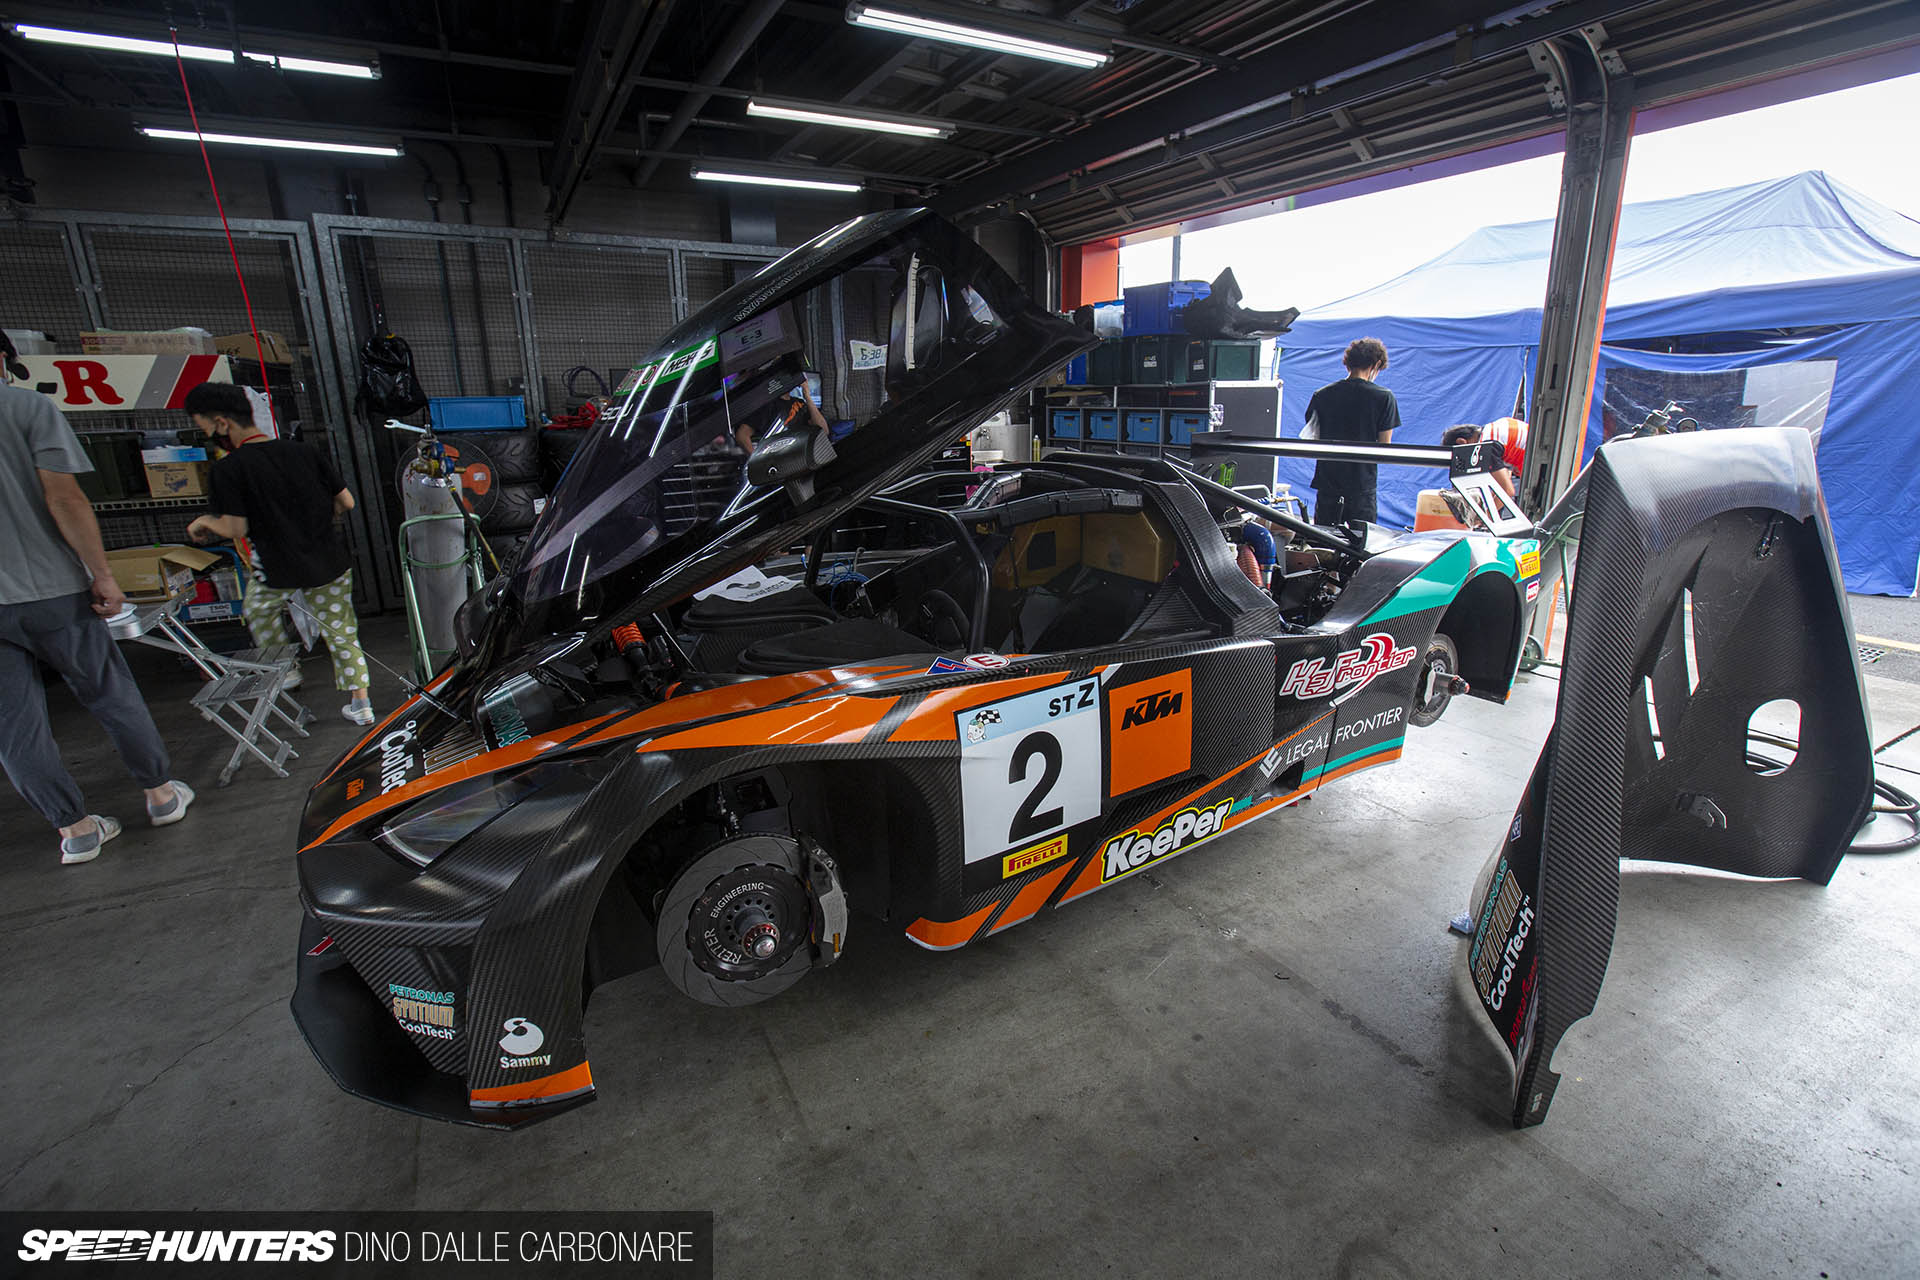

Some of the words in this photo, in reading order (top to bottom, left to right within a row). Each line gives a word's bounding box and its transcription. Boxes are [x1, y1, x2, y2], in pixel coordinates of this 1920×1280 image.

[1120, 689, 1184, 731] KTM
[1286, 732, 1330, 765] LEGAL
[1334, 706, 1403, 745] FRONTIER
[1008, 730, 1065, 845] 2
[1008, 840, 1063, 873] PIRELLI
[1103, 800, 1232, 881] KeePer
[710, 881, 765, 919] ENGINEERING
[704, 927, 742, 965] REITER
[388, 983, 456, 1005] PETRONAS
[499, 1054, 552, 1070] Sammy
